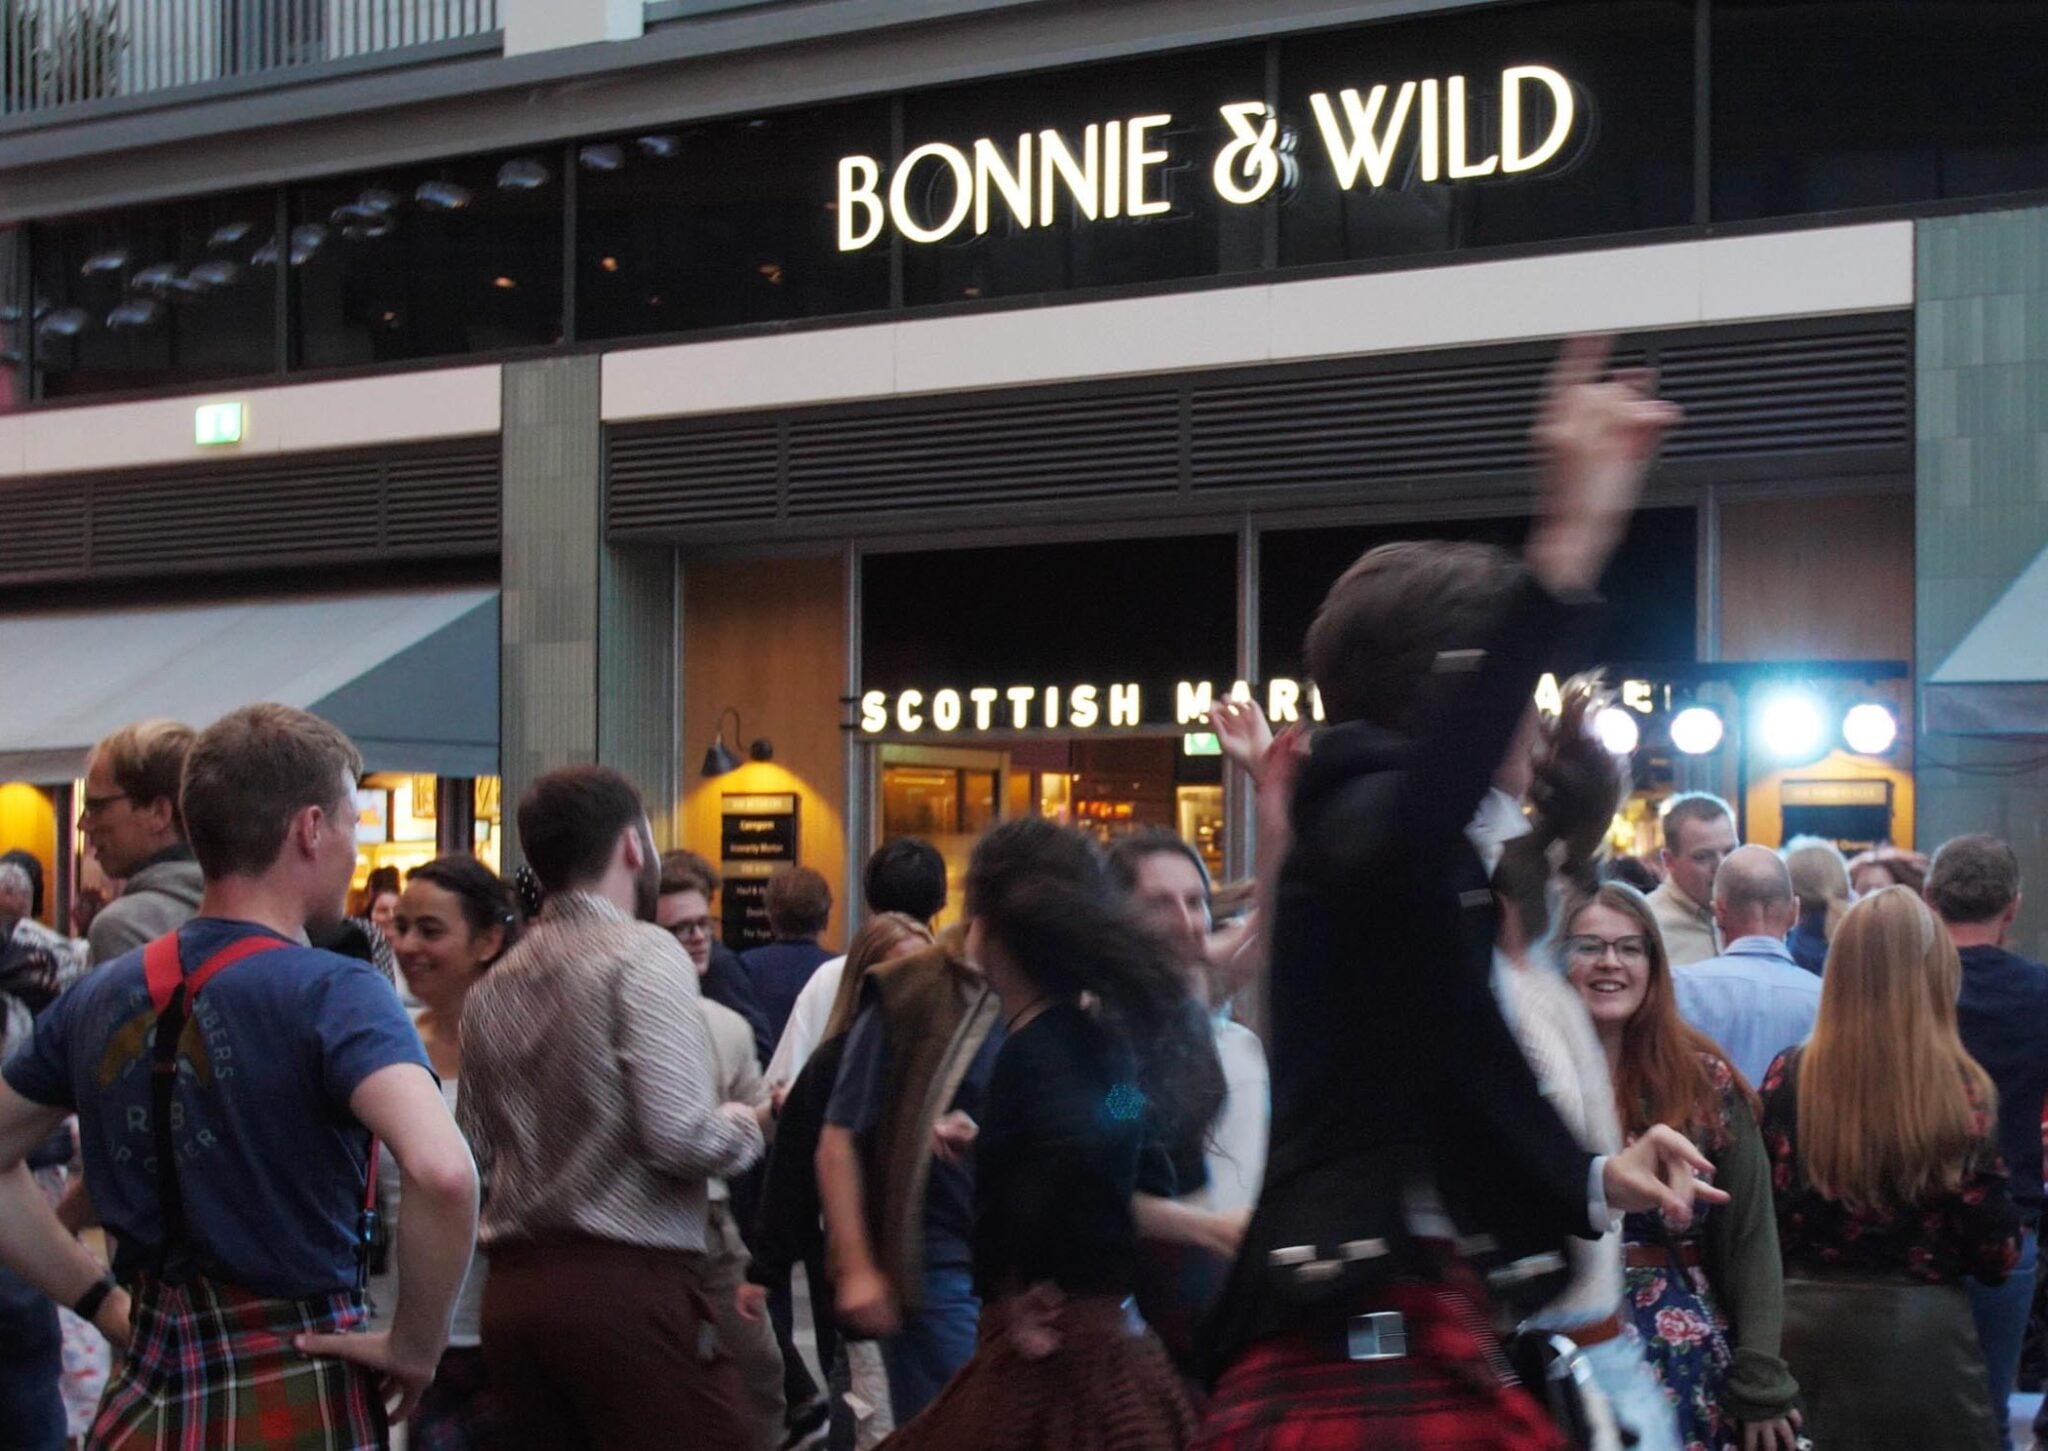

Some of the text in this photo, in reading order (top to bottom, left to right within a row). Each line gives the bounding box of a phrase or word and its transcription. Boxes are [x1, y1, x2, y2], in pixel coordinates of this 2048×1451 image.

[839, 66, 1573, 251] BONNIE & WILD
[862, 684, 1139, 732] SCOTTISH
